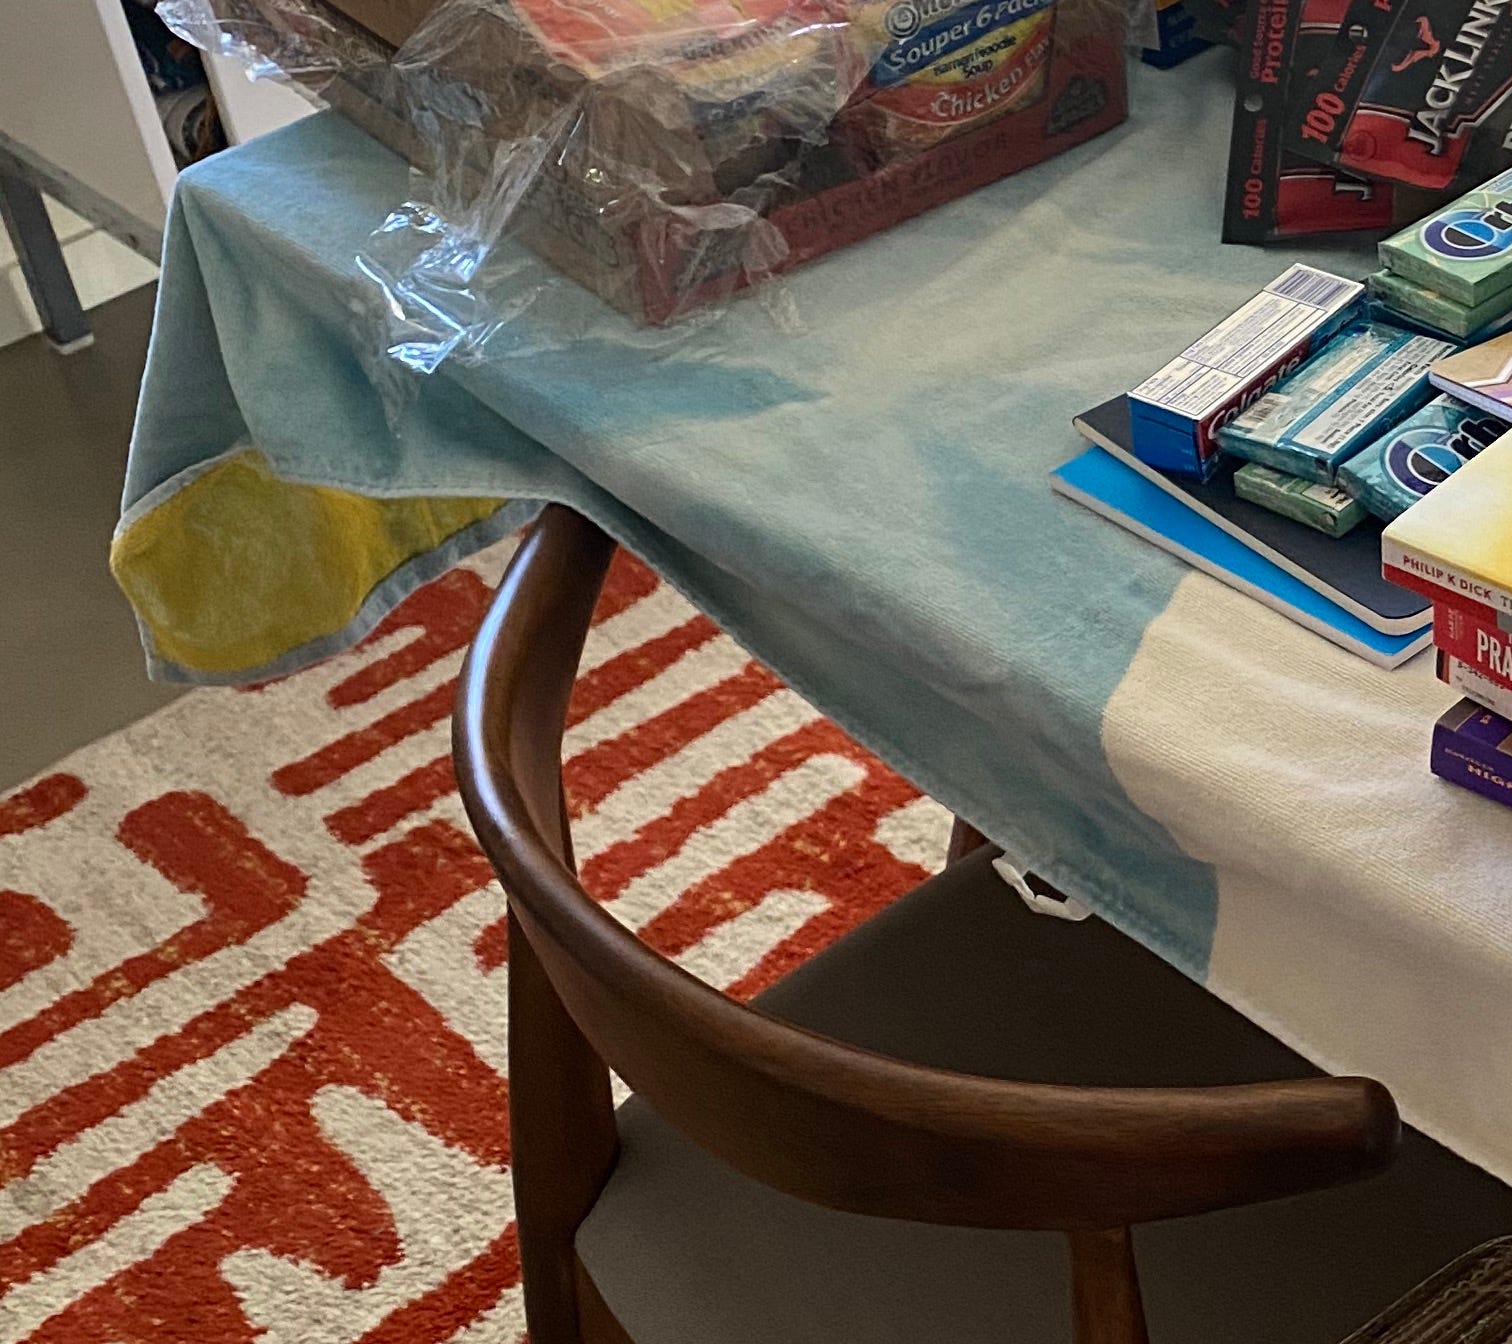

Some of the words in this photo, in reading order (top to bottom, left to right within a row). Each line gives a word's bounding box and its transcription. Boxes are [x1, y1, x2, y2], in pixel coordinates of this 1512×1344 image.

[888, 19, 973, 69] Souper
[975, 6, 995, 28] 6
[933, 63, 1024, 118] Chicken
[963, 60, 995, 81] Soup
[1302, 92, 1345, 144] 100
[1242, 178, 1263, 219] 100
[1403, 555, 1444, 579] PHILIP
[1448, 574, 1456, 585] K
[1460, 576, 1493, 600] DICK
